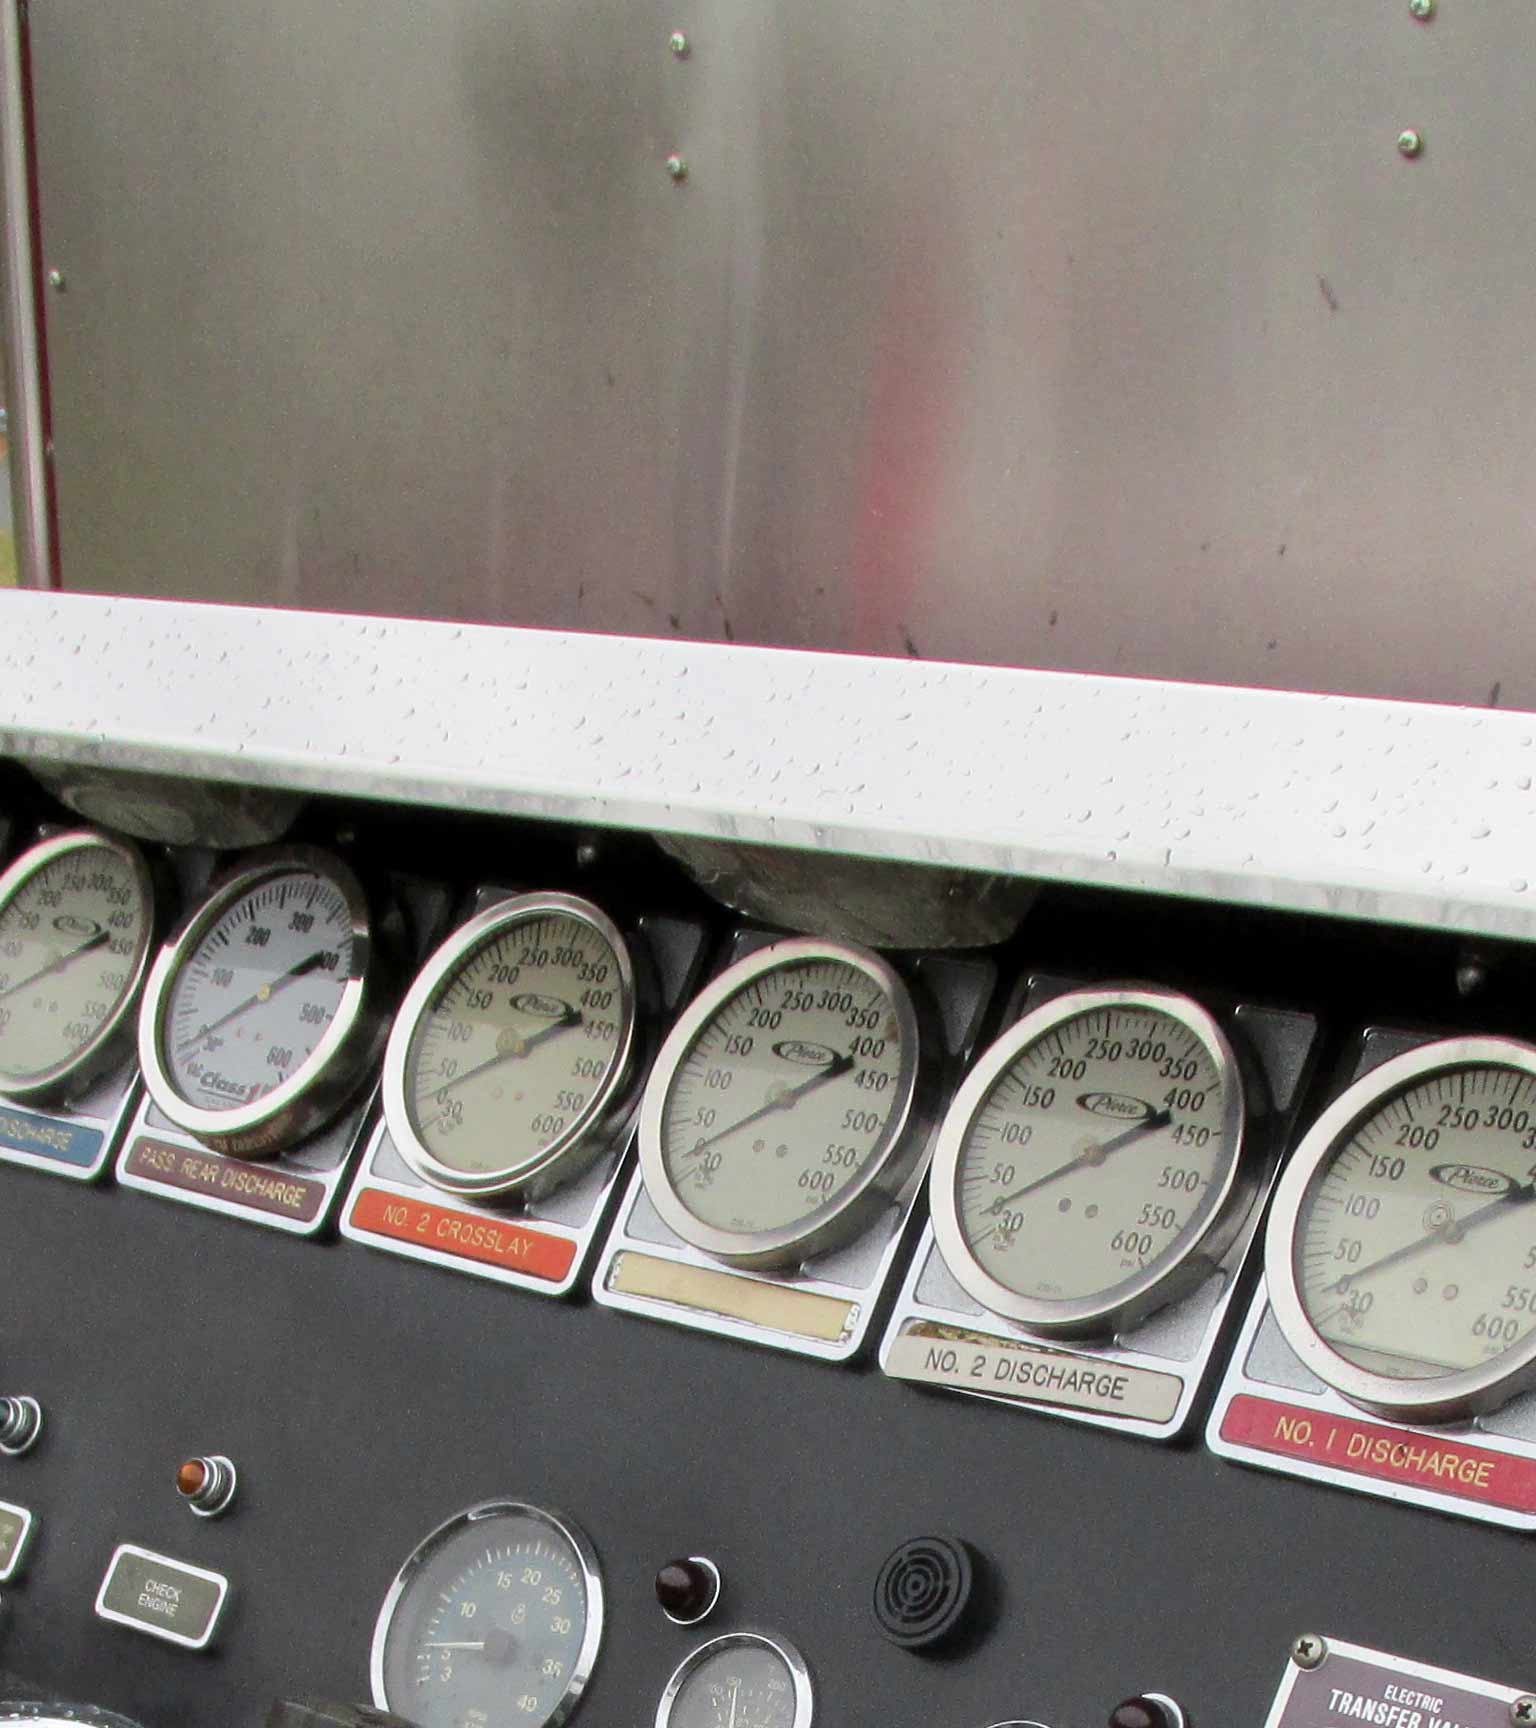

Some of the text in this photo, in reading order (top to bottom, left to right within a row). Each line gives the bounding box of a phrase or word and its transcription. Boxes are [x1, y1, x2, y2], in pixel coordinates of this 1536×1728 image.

[288, 911, 315, 933] 300
[246, 926, 272, 947] 200
[518, 947, 548, 969] 250
[551, 948, 583, 968] 300
[488, 963, 520, 985] 200
[576, 962, 608, 984] 350
[466, 987, 494, 1010] 150
[581, 988, 613, 1010] 400
[781, 990, 815, 1013] 250
[816, 989, 853, 1014] 300
[299, 1003, 326, 1024] 500
[747, 1008, 782, 1030] 200
[845, 1006, 880, 1030] 350
[447, 1023, 473, 1041] 100
[583, 1020, 615, 1040] 450
[726, 1034, 754, 1056] 150
[849, 1035, 886, 1059] 400
[1084, 1038, 1123, 1062] 250
[1125, 1038, 1167, 1062] 300
[266, 1046, 293, 1068] 600
[440, 1057, 458, 1078] 50
[572, 1059, 605, 1078] 500
[1048, 1056, 1087, 1081] 200
[1159, 1056, 1198, 1081] 350
[703, 1070, 732, 1089] 100
[855, 1069, 889, 1091] 450
[554, 1090, 584, 1112] 550
[1023, 1083, 1056, 1109] 150
[1164, 1087, 1206, 1112] 400
[531, 1116, 564, 1135] 600
[693, 1107, 716, 1127] 50
[842, 1109, 878, 1132] 500
[1437, 1104, 1480, 1130] 250
[1482, 1104, 1530, 1133] 300
[1000, 1123, 1032, 1146] 100
[1172, 1125, 1211, 1148] 450
[1395, 1124, 1440, 1151] 200
[823, 1143, 857, 1168] 550
[990, 1163, 1015, 1186] 50
[1159, 1166, 1201, 1192] 500
[1369, 1154, 1406, 1181] 150
[181, 1158, 219, 1183] REAR
[220, 1167, 306, 1208] DISCHARGE
[798, 1168, 835, 1191] 600
[1138, 1203, 1177, 1230] 550
[1344, 1192, 1381, 1220] 100
[997, 1211, 1024, 1232] 30
[416, 1212, 431, 1233] 2
[436, 1218, 535, 1257] CROSSLAY
[1111, 1230, 1153, 1255] 600
[1334, 1238, 1362, 1264] 50
[1472, 1312, 1520, 1341] 600
[924, 1345, 1130, 1403] NO. 2 DISCHARGE
[1273, 1414, 1316, 1448] NO.
[1346, 1430, 1497, 1490] DISCHARGE
[496, 1571, 513, 1589] 15
[520, 1567, 541, 1585] 20
[144, 1578, 184, 1602] CHECK
[542, 1586, 562, 1605] 25
[137, 1591, 180, 1617] ENGINE
[460, 1602, 476, 1618] 10
[550, 1616, 571, 1634] 30
[1384, 1683, 1444, 1714] ELECTRIC
